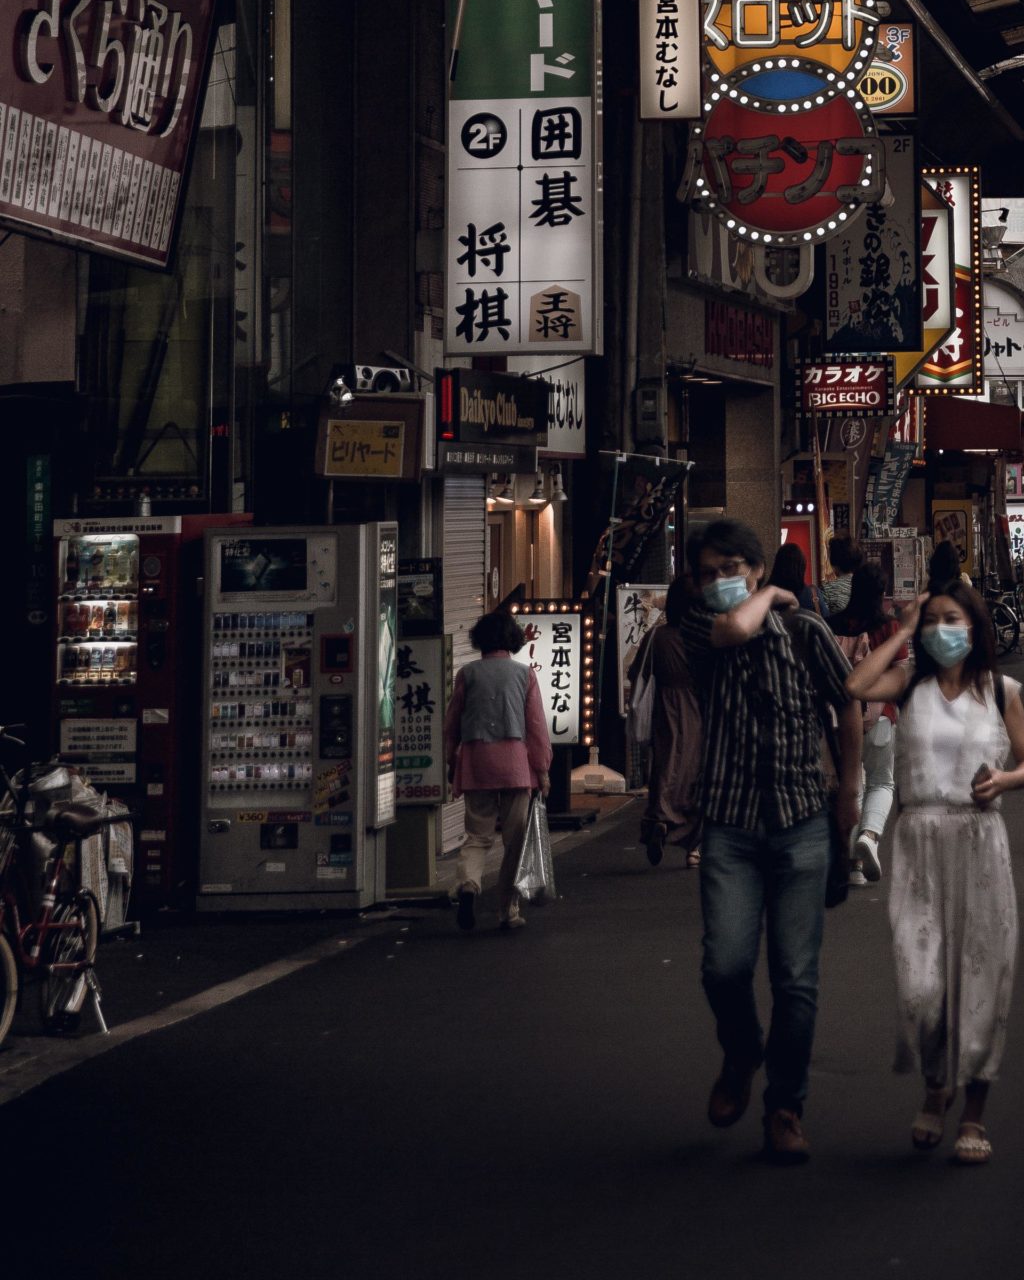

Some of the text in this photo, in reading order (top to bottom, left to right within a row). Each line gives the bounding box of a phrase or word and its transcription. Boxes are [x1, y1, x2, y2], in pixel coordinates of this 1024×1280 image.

[886, 26, 910, 44] 3F
[467, 122, 503, 152] 2F
[893, 139, 911, 153] 2F
[529, 106, 585, 228] 囲碁
[676, 136, 887, 205] パチンコ
[842, 238, 851, 285] ハイボール
[456, 221, 512, 343] 将棋
[534, 291, 578, 340] 王将
[804, 365, 884, 384] カラオケ
[808, 390, 881, 407] BIG ECHO
[331, 440, 397, 464] ビリヤード
[550, 622, 573, 736] 宮本むなし
